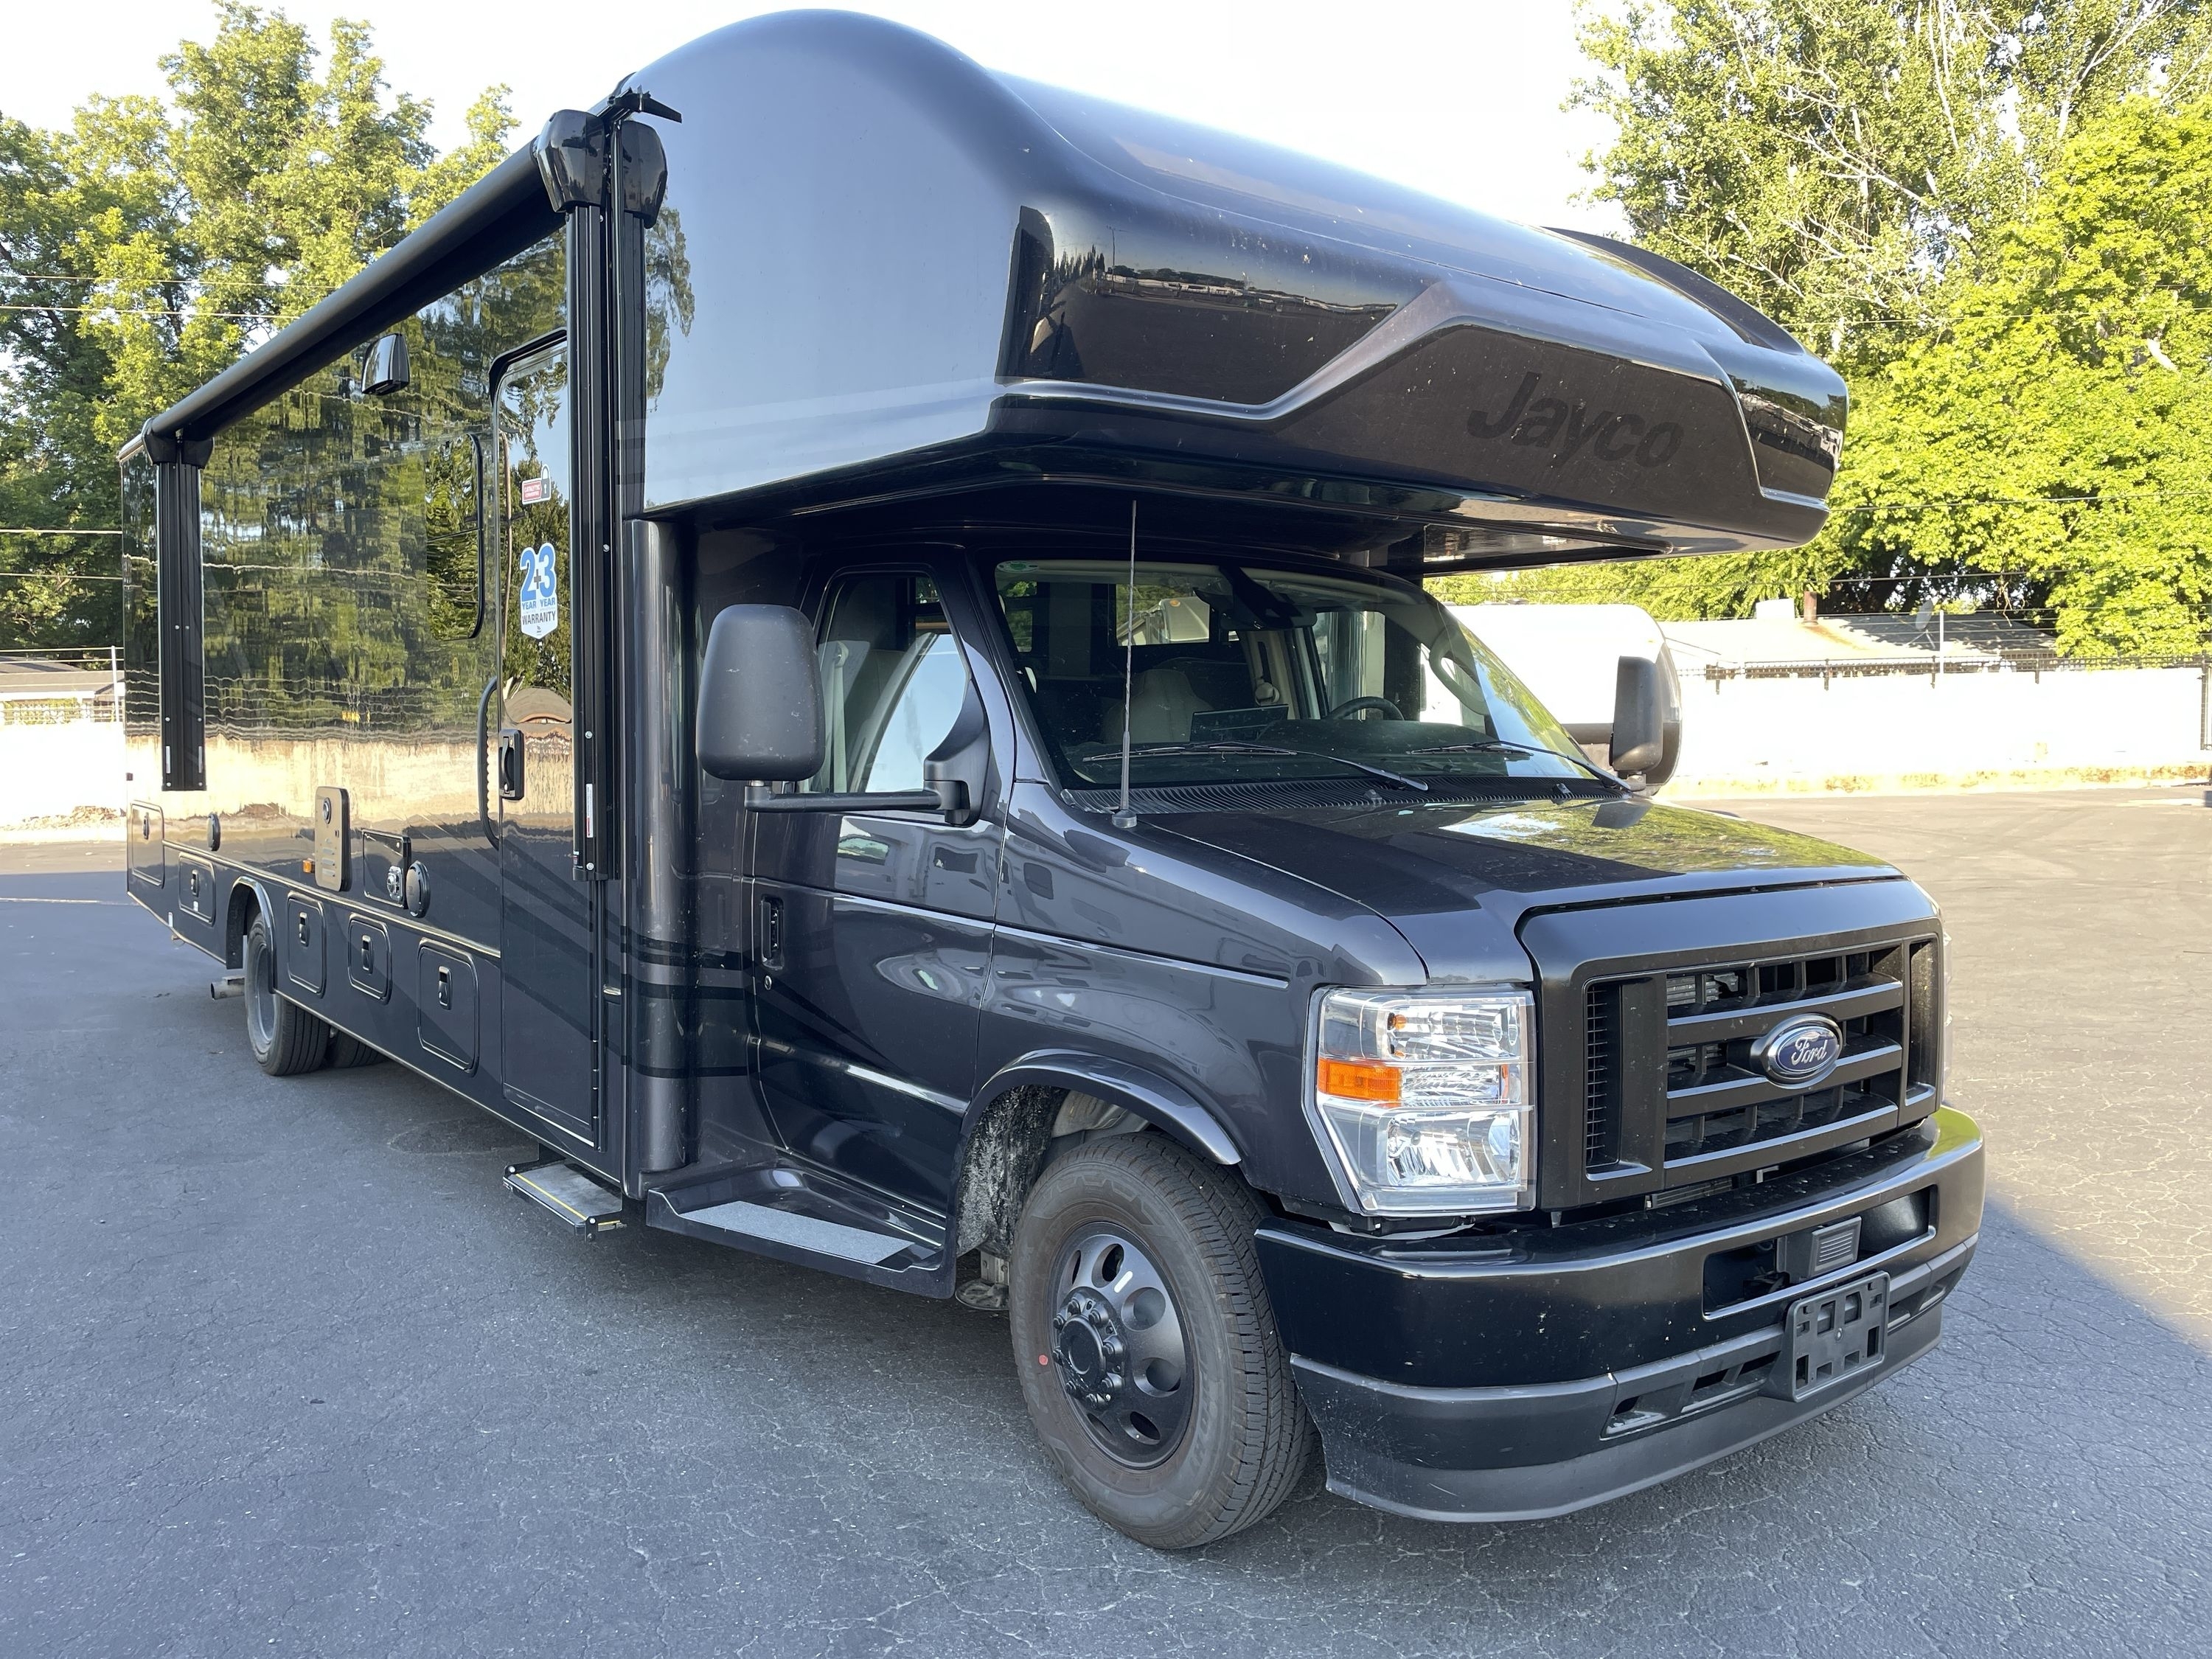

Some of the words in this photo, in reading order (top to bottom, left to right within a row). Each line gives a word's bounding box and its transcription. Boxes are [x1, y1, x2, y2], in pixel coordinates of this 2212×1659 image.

[1467, 371, 1685, 470] Jayco
[522, 601, 537, 610] YEAR
[540, 597, 556, 607] YEAR
[522, 611, 555, 625] WARRANTY
[1791, 1034, 1828, 1065] Ford
